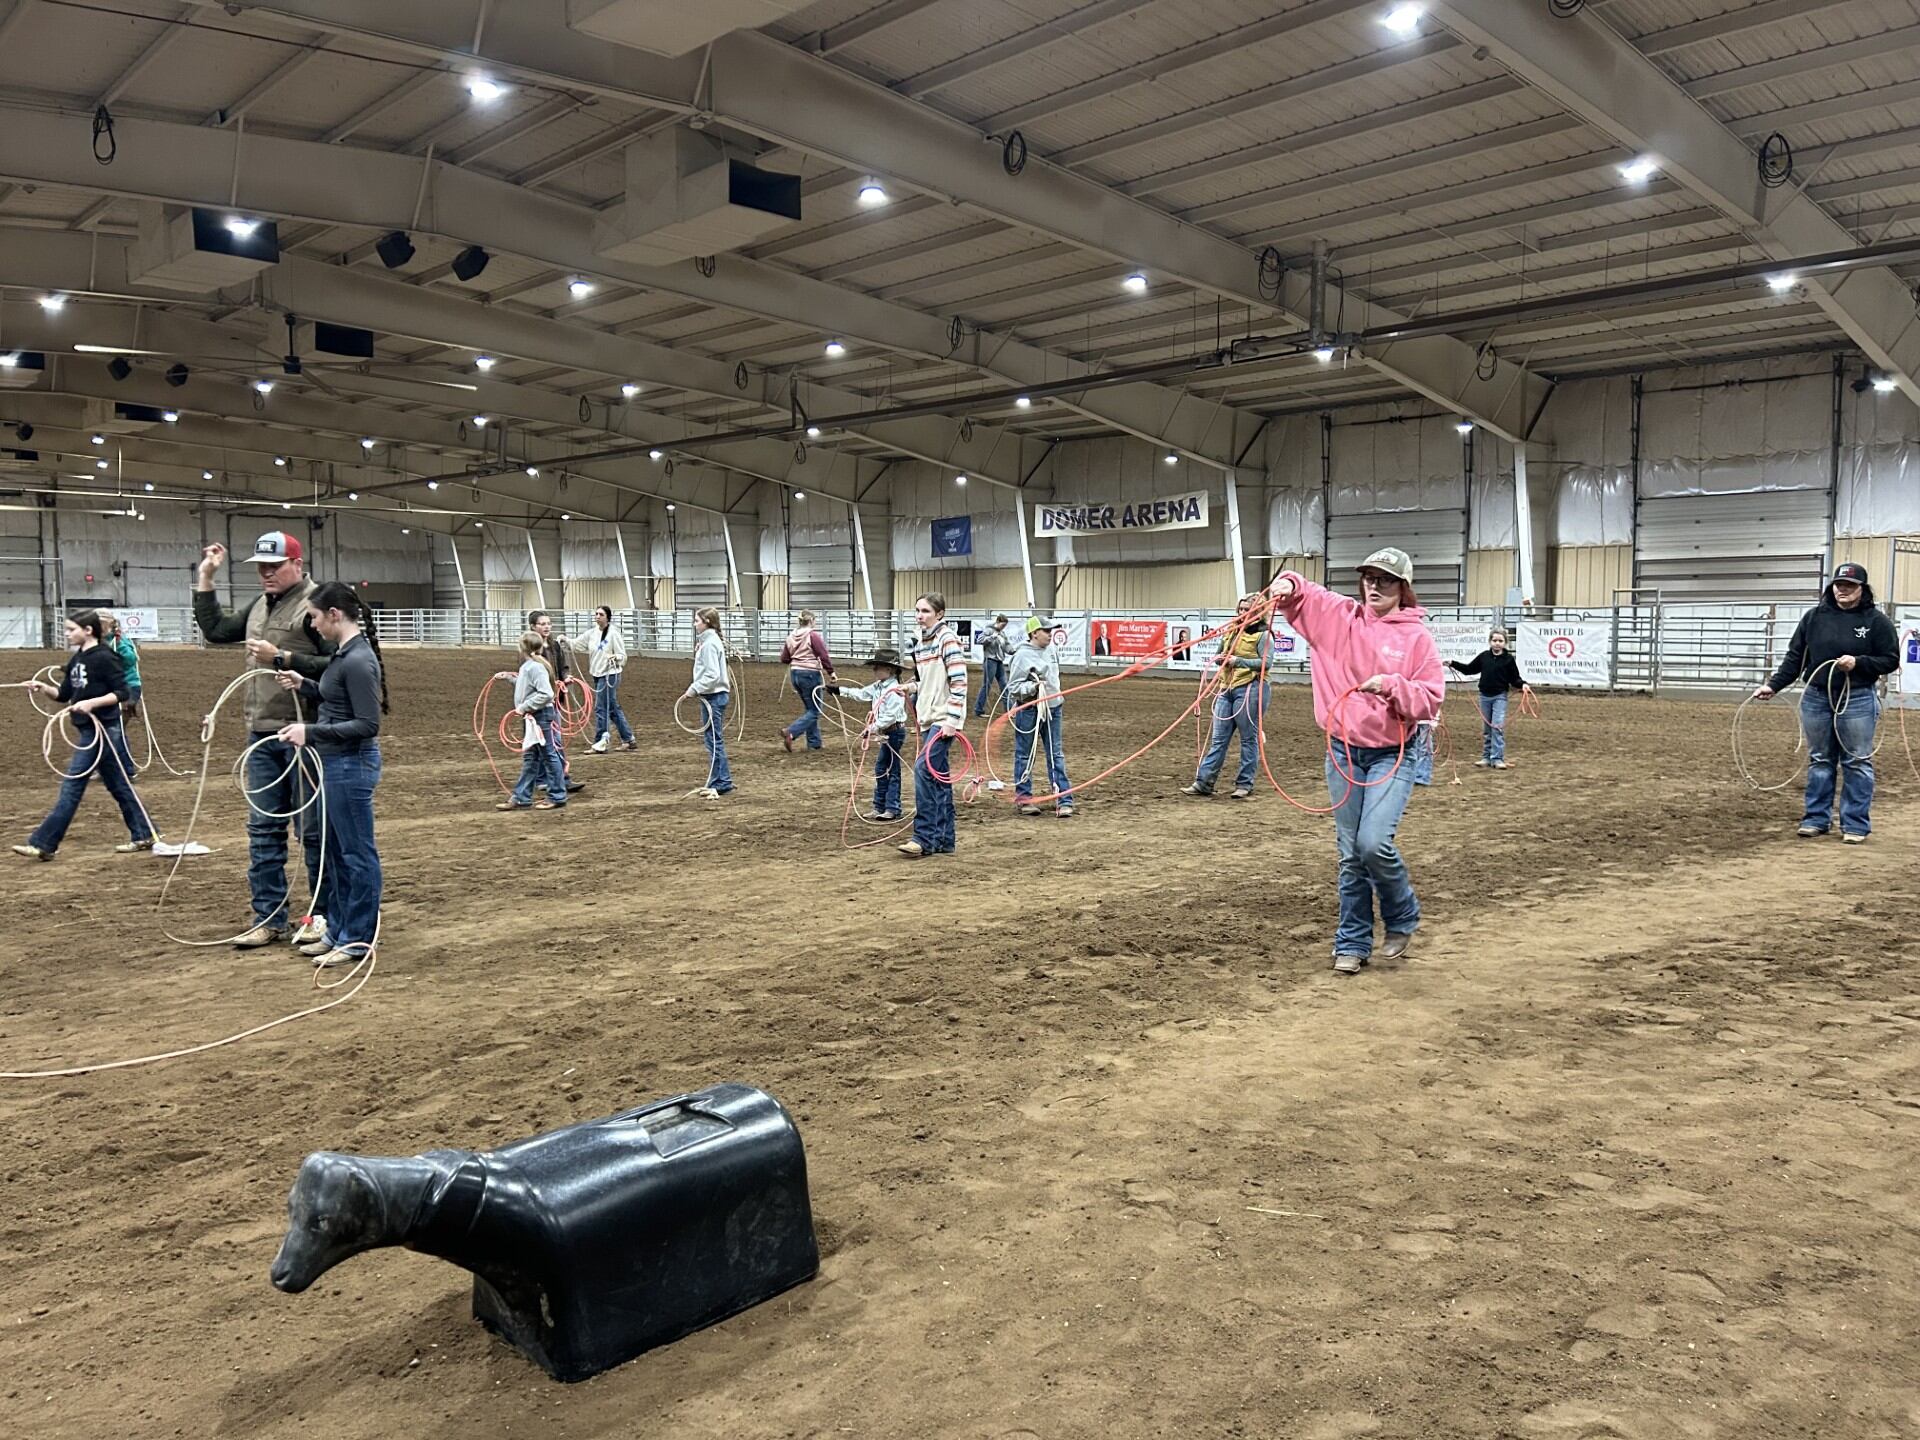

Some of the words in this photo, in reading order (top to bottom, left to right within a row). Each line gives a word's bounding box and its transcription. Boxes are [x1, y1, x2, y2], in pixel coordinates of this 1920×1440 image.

[1042, 506, 1115, 530] DOMER
[1122, 497, 1200, 528] ARENA
[1118, 624, 1128, 632] Jim
[1129, 624, 1149, 632] Martin
[1539, 627, 1574, 636] TWISTED
[1577, 627, 1584, 636] B
